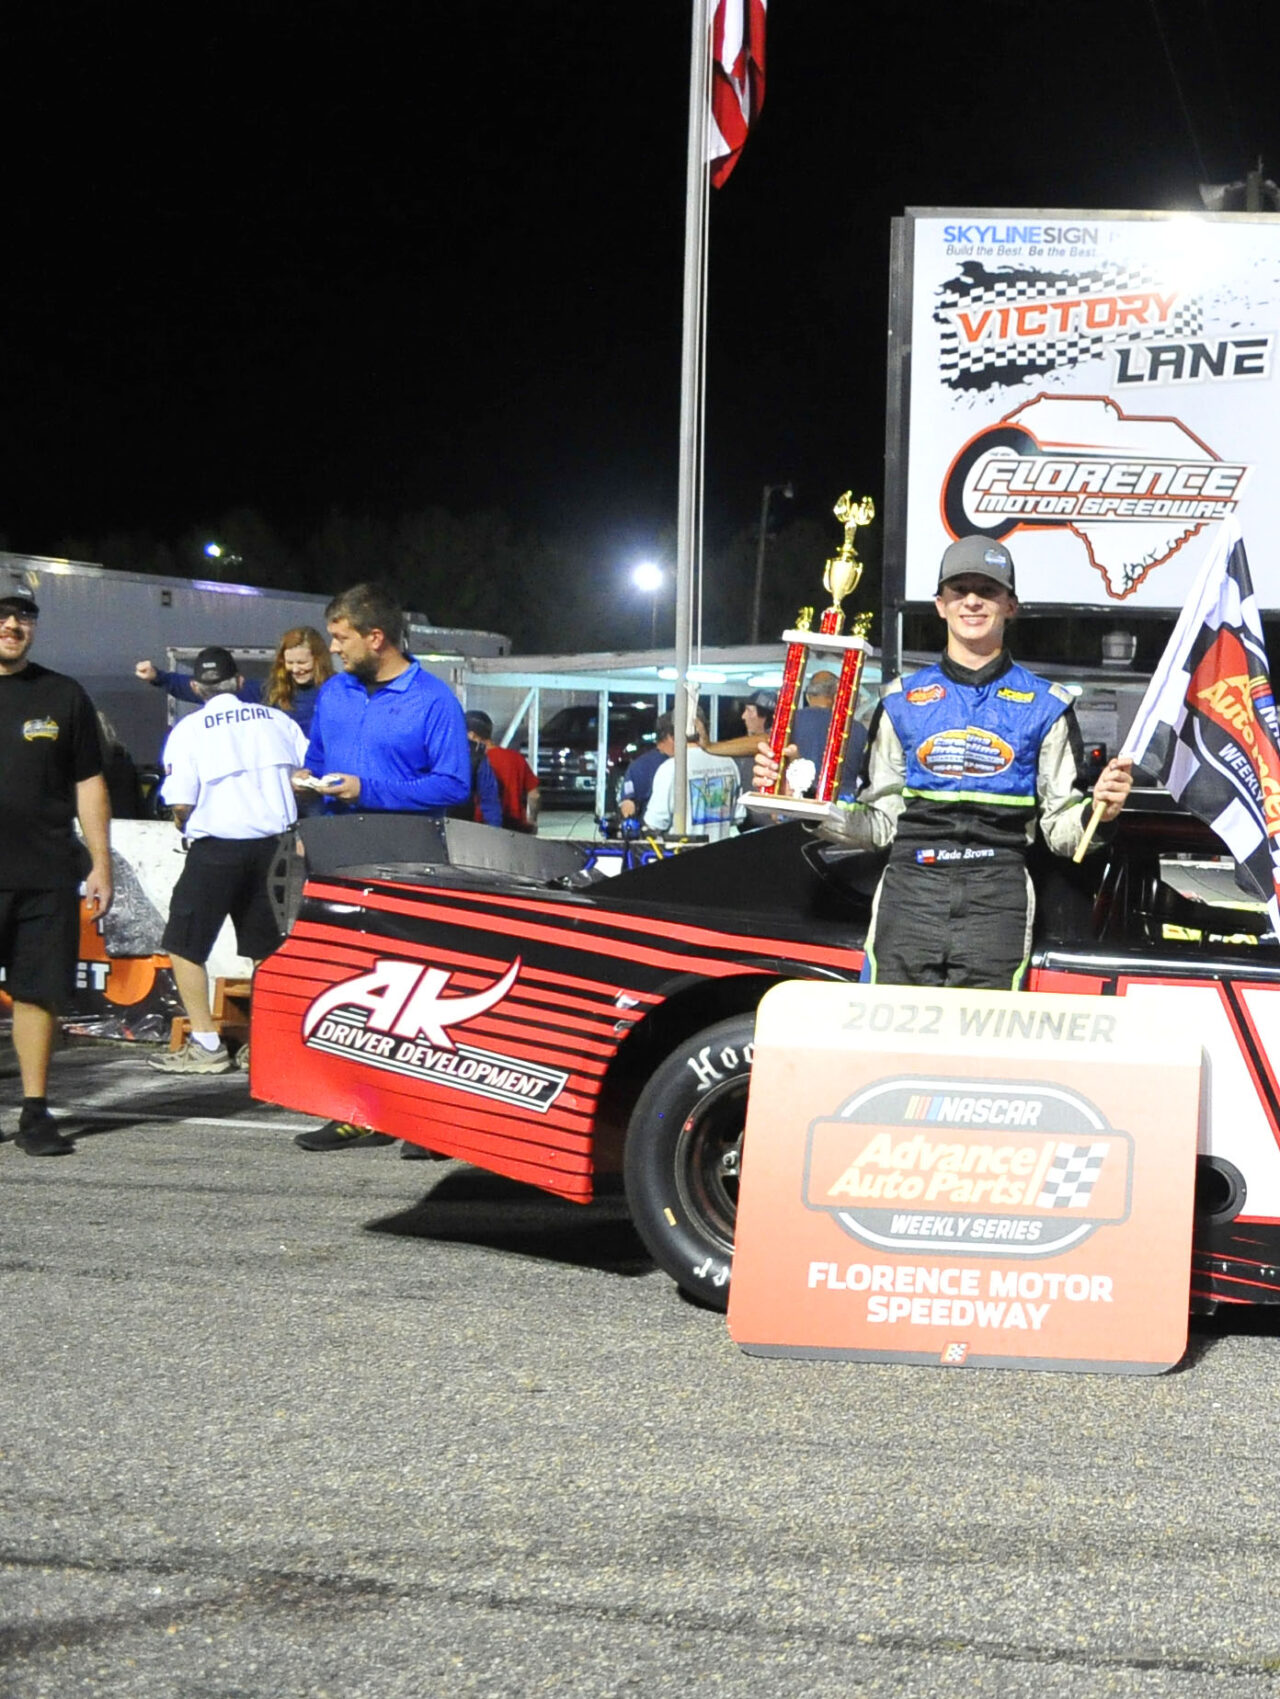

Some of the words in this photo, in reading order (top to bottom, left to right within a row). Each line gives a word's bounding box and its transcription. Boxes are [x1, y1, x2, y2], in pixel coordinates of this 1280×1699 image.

[946, 245, 973, 256] Build
[976, 245, 993, 256] the
[1028, 246, 1044, 256] Be
[1047, 246, 1065, 257] the
[956, 291, 1179, 344] VICTORY
[1114, 337, 1269, 384] LANE
[974, 460, 1248, 498] FLORENCE
[976, 493, 1078, 515] MOTOR
[1078, 497, 1238, 518] SPEEDWAY
[204, 707, 275, 729] OFFICIAL
[1218, 742, 1266, 802] WEEKLY
[303, 954, 521, 1050] AK
[842, 1002, 941, 1035] 2022
[960, 1007, 1117, 1043] WINNER
[316, 1020, 396, 1057] DRIVER
[396, 1044, 550, 1097] DEVELOPMENT
[938, 1096, 1043, 1126] NASCAR
[852, 1132, 1037, 1176] Advance
[828, 1166, 920, 1201] Auto
[925, 1171, 1025, 1206] Parts
[890, 1214, 970, 1237] WEEKLY
[970, 1218, 1042, 1241] SERIES
[807, 1262, 980, 1296] FLORENCE
[989, 1269, 1114, 1302] MOTOR
[866, 1296, 1051, 1330] SPEEDWAY
